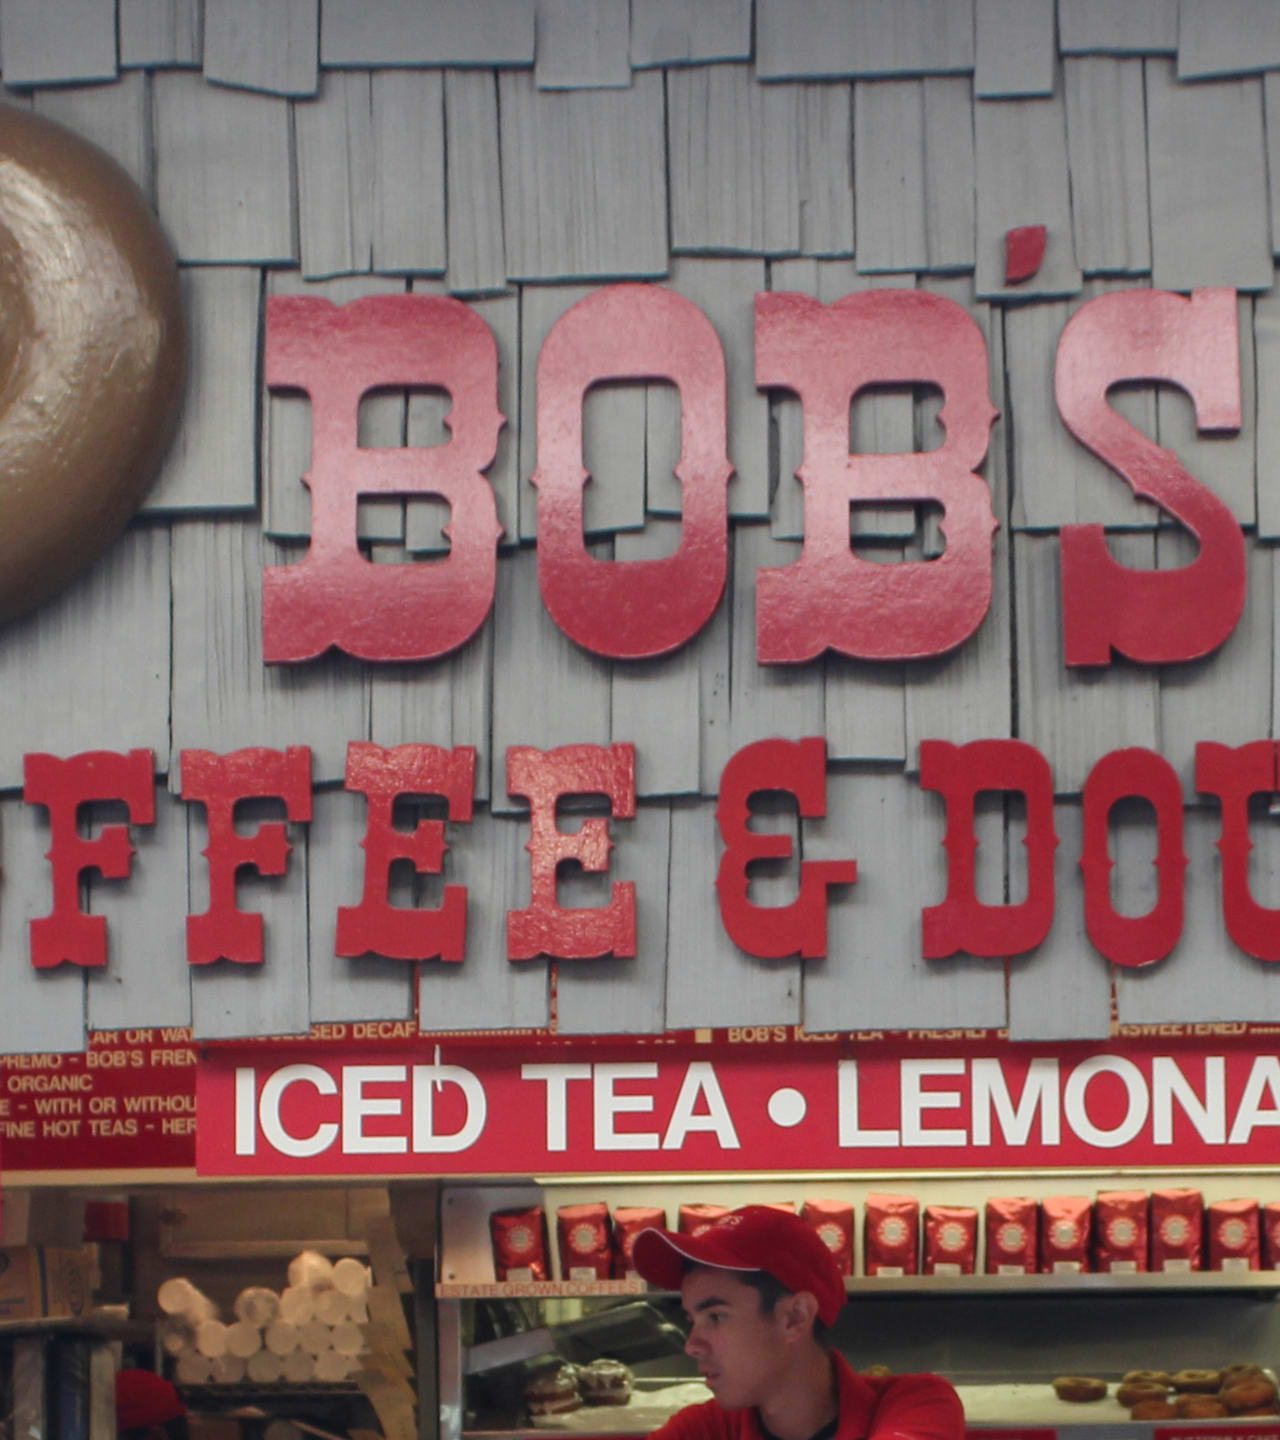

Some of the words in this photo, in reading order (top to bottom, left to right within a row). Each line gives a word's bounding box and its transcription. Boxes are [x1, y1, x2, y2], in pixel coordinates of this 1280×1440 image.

[264, 224, 1249, 667] BOB'S
[716, 736, 858, 960] &
[353, 1022, 416, 1039] DECAF
[728, 1026, 787, 1042] BOB'S
[87, 1051, 143, 1068] BOB'S
[7, 1075, 93, 1092] ORGANIC
[35, 1099, 82, 1115] WITH
[89, 1098, 116, 1114] OR
[234, 1064, 487, 1157] ICED
[522, 1061, 741, 1153] TEA
[43, 1120, 81, 1136] HOT
[88, 1119, 137, 1136] TEAS
